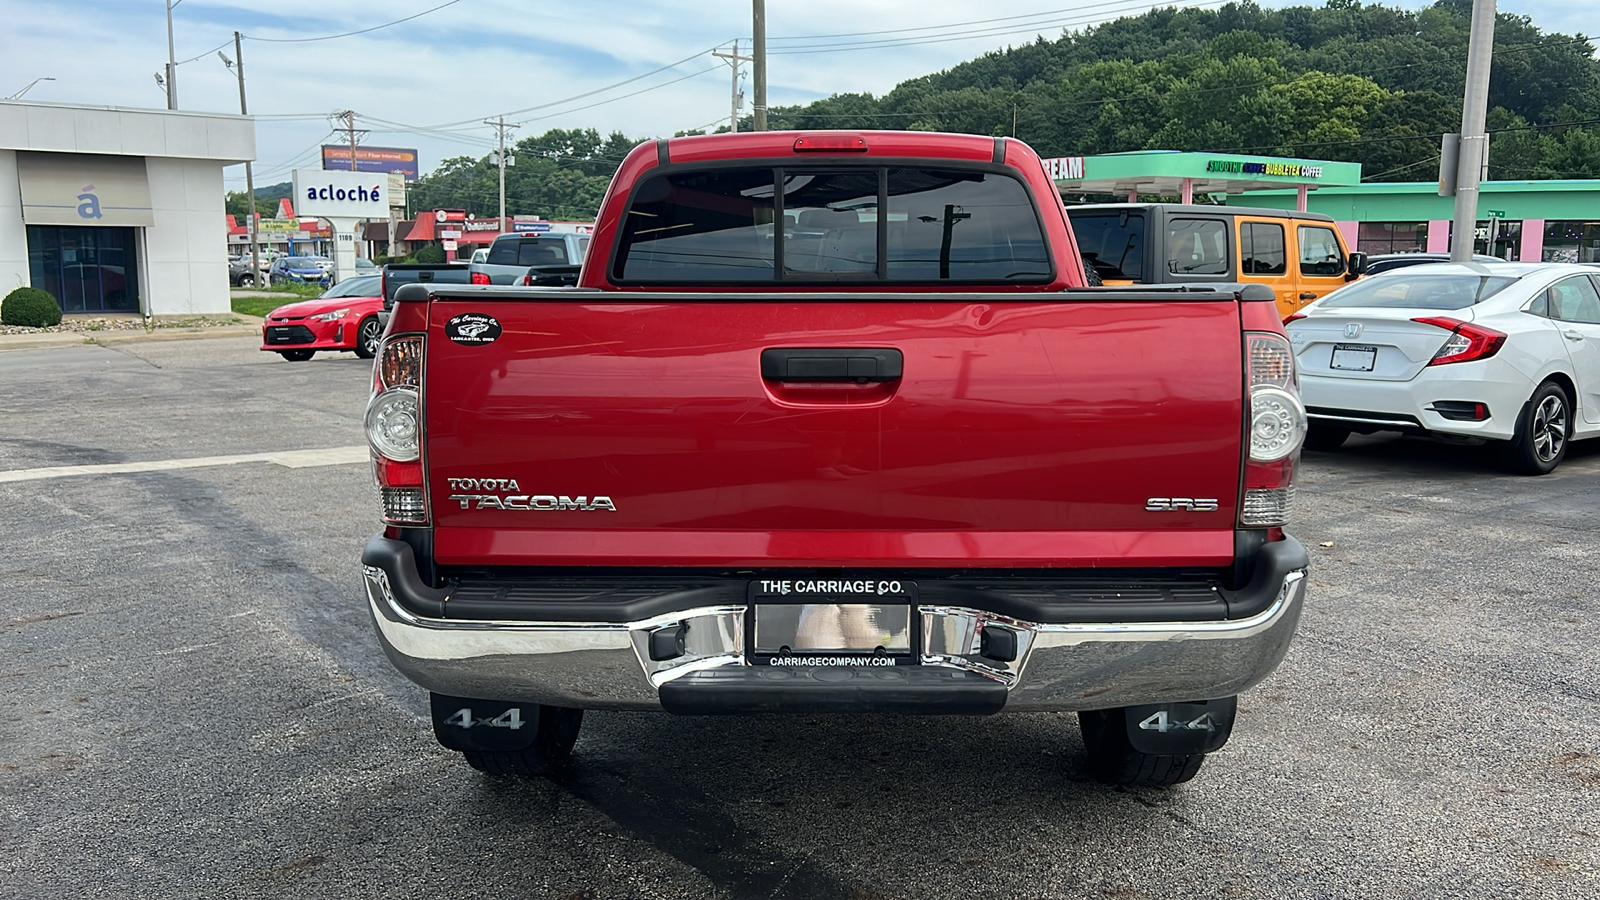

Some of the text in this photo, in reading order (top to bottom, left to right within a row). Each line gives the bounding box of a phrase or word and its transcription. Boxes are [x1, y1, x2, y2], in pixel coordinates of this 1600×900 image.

[1209, 160, 1243, 173] SMOOTHIE
[1301, 165, 1323, 178] COFFEE
[307, 184, 380, 202] acloché
[447, 477, 521, 492] TOYOTA
[448, 494, 617, 512] TACOMA
[1145, 497, 1219, 511] SR5
[761, 580, 905, 594] THE CARRIAGE CO.
[769, 657, 896, 667] CARRIAGECOMPANY.COM
[443, 707, 526, 730] 4x4
[1139, 710, 1217, 733] 4x4
